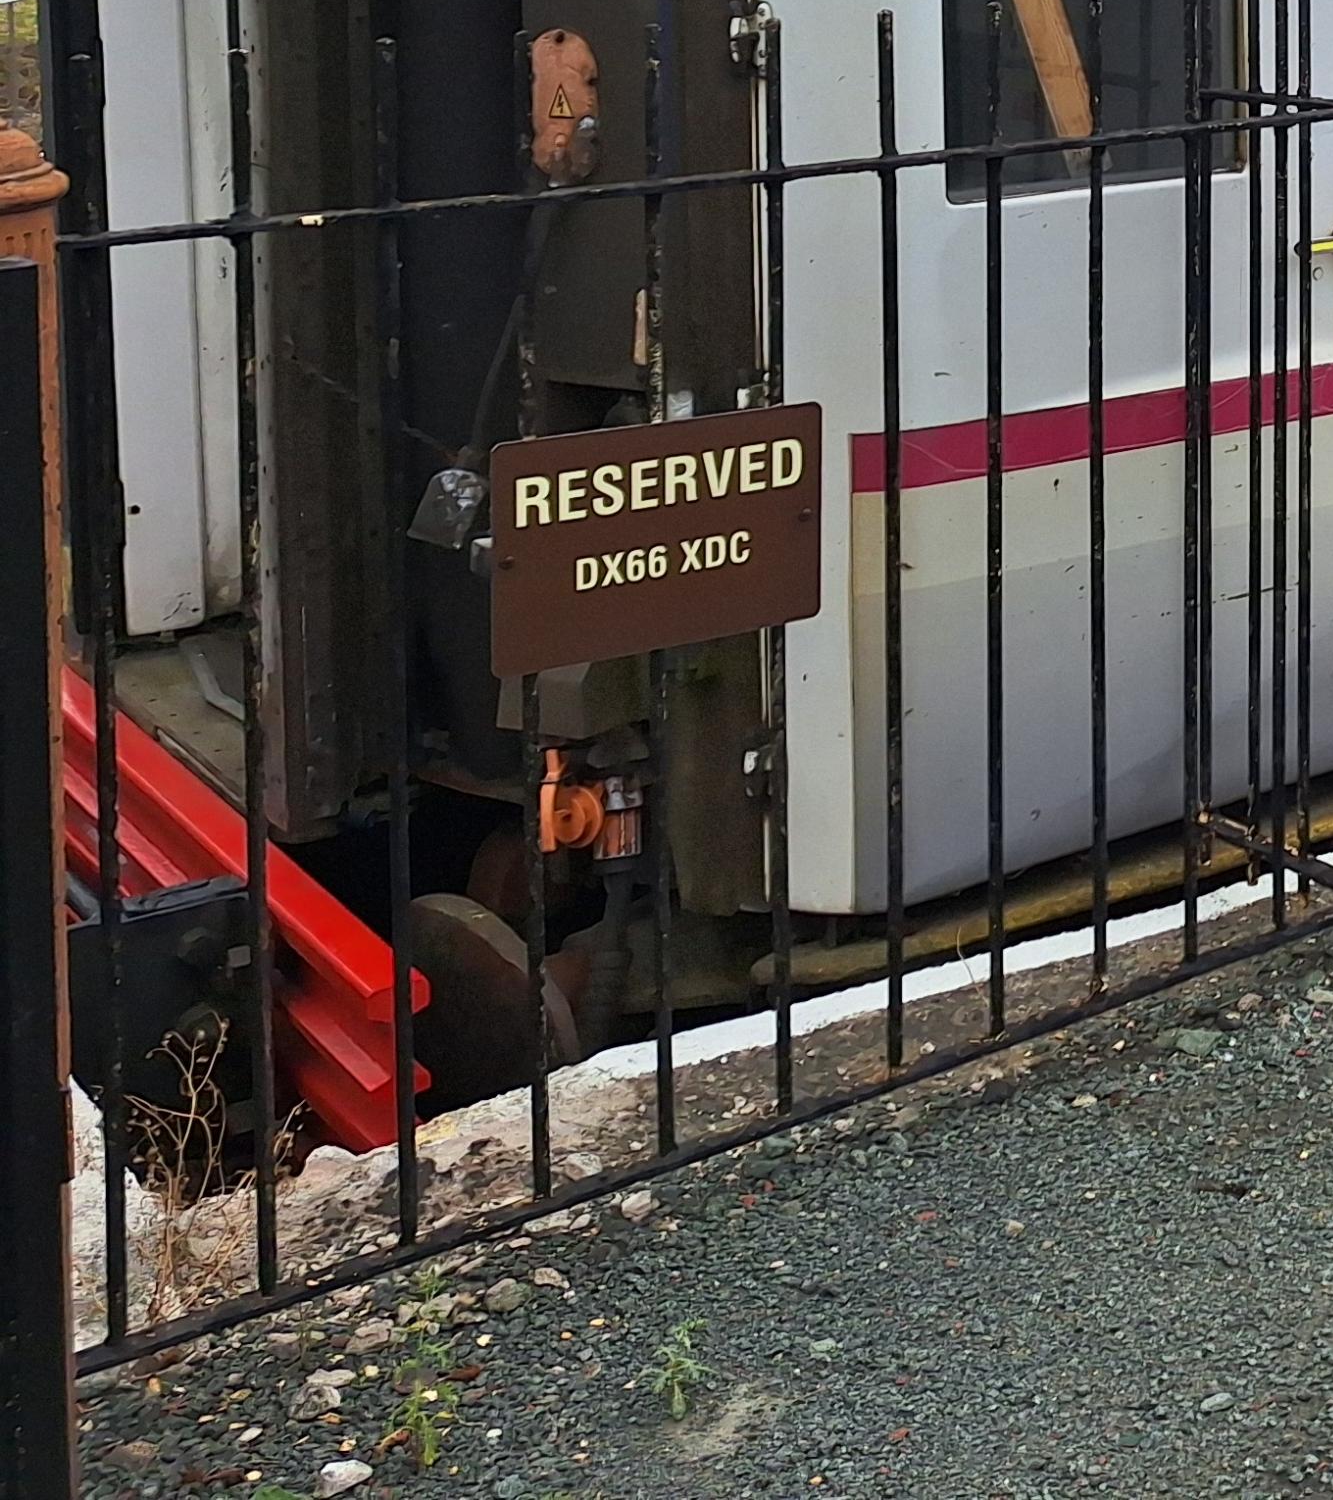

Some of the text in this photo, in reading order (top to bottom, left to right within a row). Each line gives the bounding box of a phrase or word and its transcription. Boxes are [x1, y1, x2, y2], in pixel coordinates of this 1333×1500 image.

[514, 438, 803, 529] RESERVED
[575, 529, 752, 592] DX66 XDC
